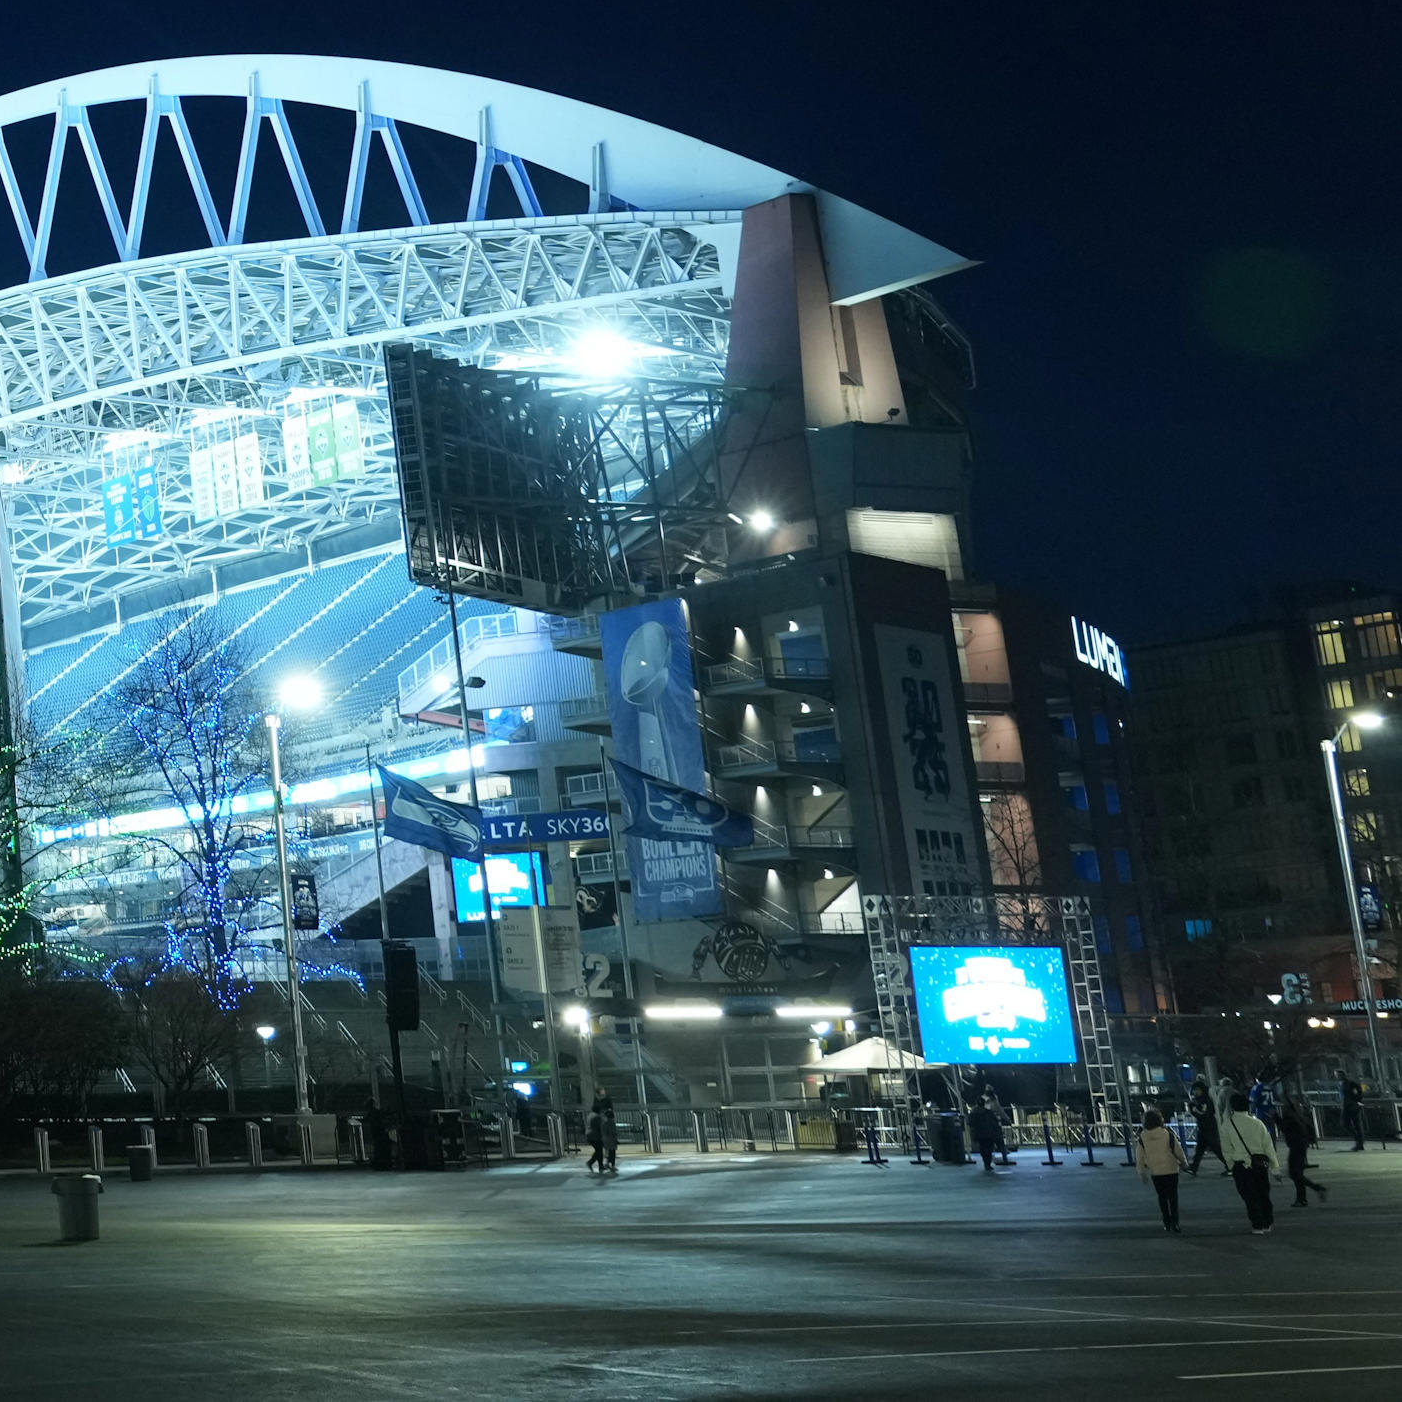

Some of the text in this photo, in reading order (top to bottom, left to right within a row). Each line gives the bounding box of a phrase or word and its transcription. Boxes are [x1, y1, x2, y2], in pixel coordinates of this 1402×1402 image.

[1071, 615, 1125, 687] LUMEN
[482, 820, 532, 840] LTA
[644, 854, 707, 882] CHAMPIONS
[585, 953, 613, 998] 2
[1341, 999, 1402, 1011] MUCESHO
